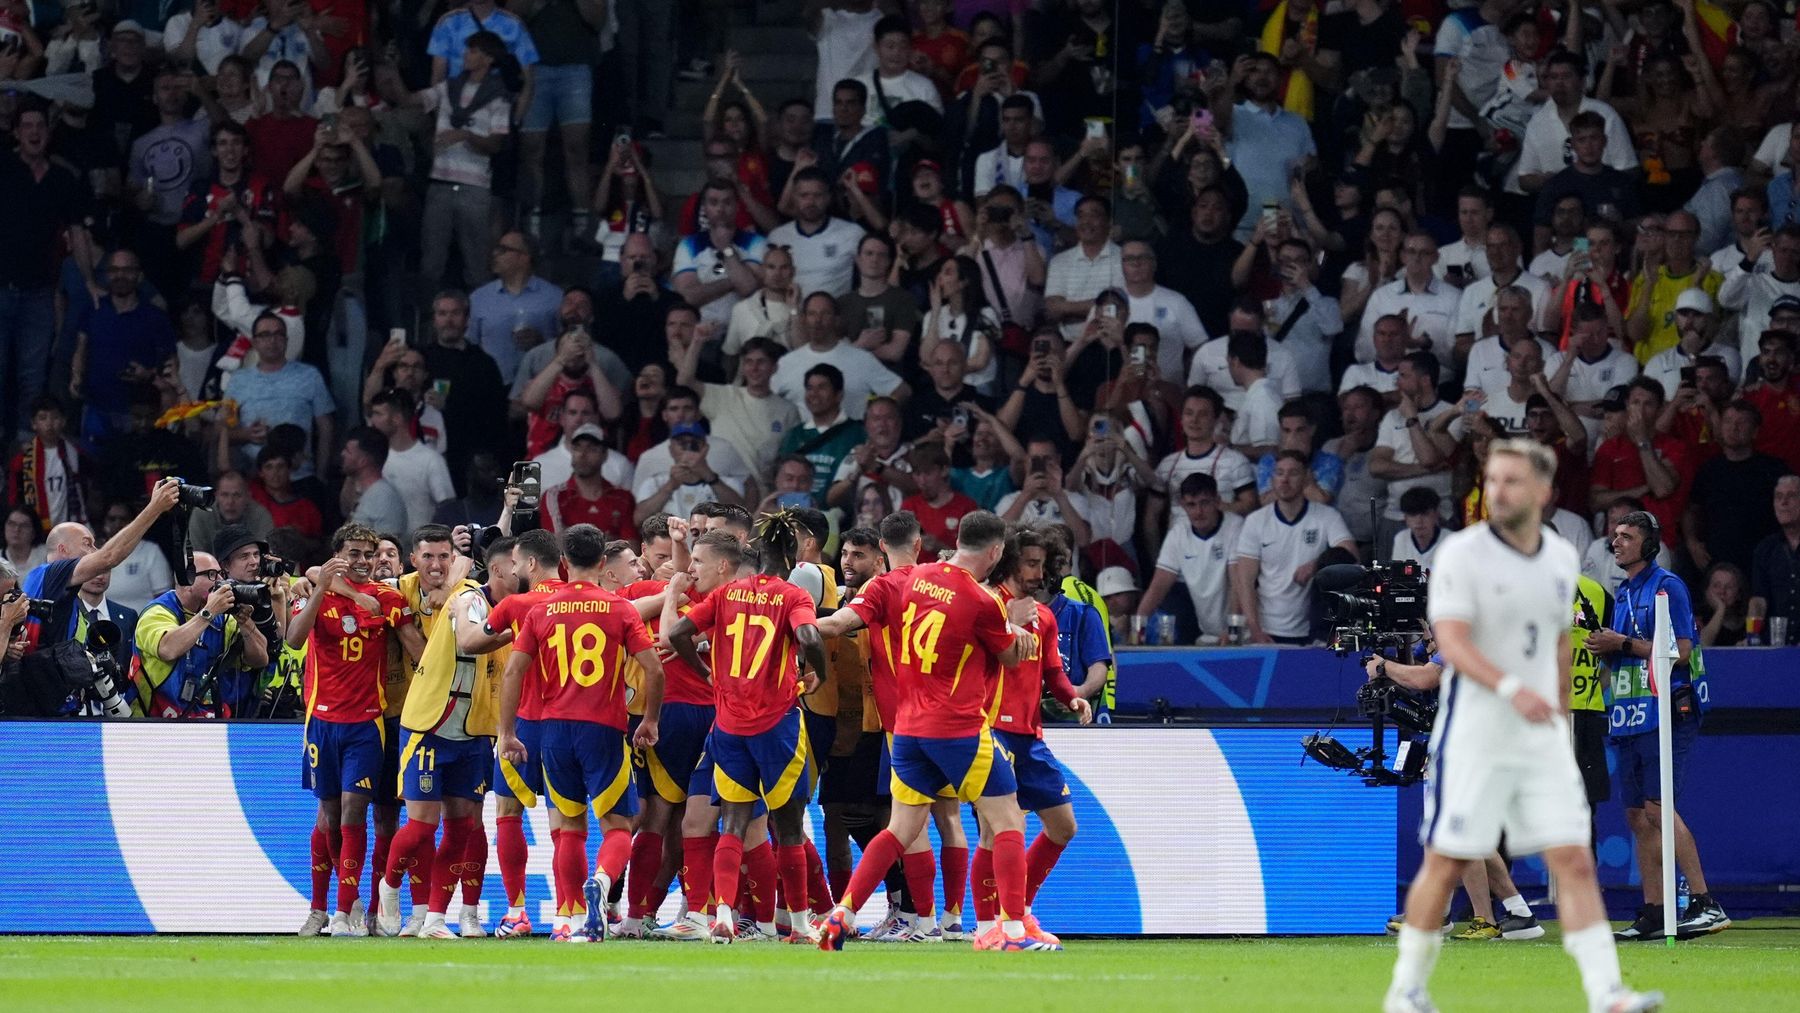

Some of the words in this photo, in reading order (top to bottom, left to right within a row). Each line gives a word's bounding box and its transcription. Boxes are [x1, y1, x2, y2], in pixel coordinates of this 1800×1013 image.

[48, 476, 62, 492] 17
[770, 594, 784, 606] JR
[912, 578, 956, 604] LAPORTE
[546, 600, 611, 616] ZUBIMENDI
[339, 636, 363, 662] 19
[726, 613, 776, 679] 17
[901, 602, 946, 674] 14
[1522, 622, 1539, 659] 3
[547, 623, 607, 687] 18
[416, 746, 435, 771] 11
